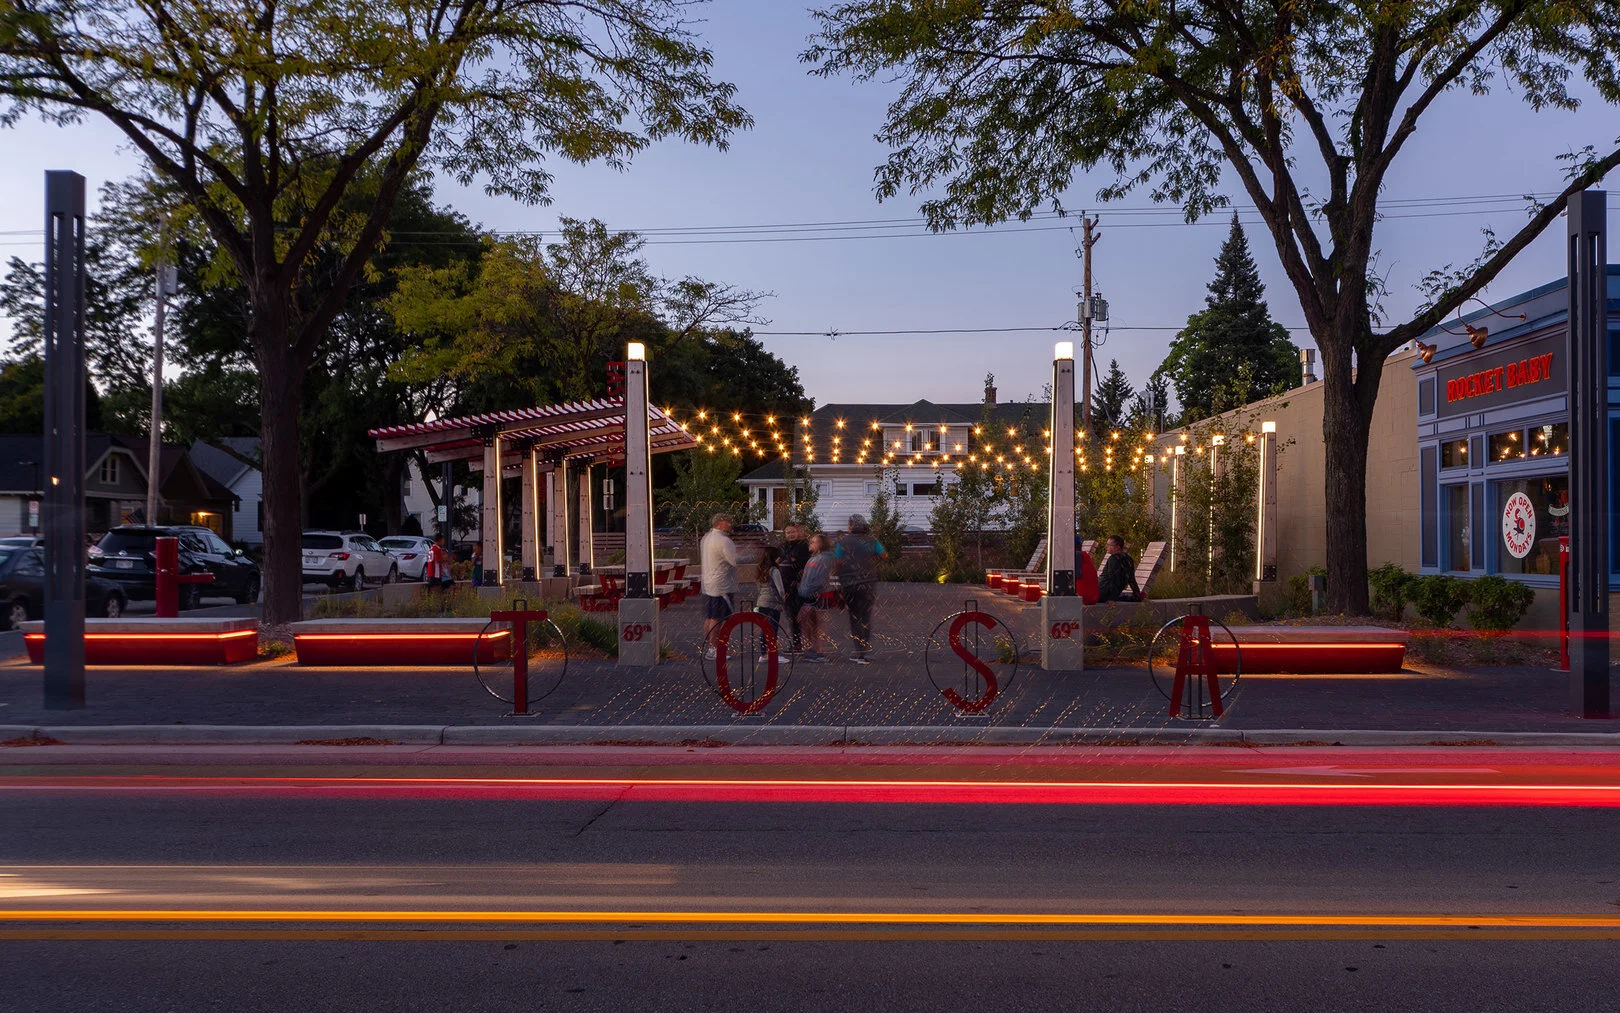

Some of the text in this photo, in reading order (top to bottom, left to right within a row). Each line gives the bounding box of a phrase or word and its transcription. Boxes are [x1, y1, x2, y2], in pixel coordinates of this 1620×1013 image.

[1447, 351, 1553, 402] ROCKET BABY
[1505, 497, 1517, 518] NOW
[1518, 496, 1533, 519] OPEN
[1506, 531, 1532, 553] MONDAYS
